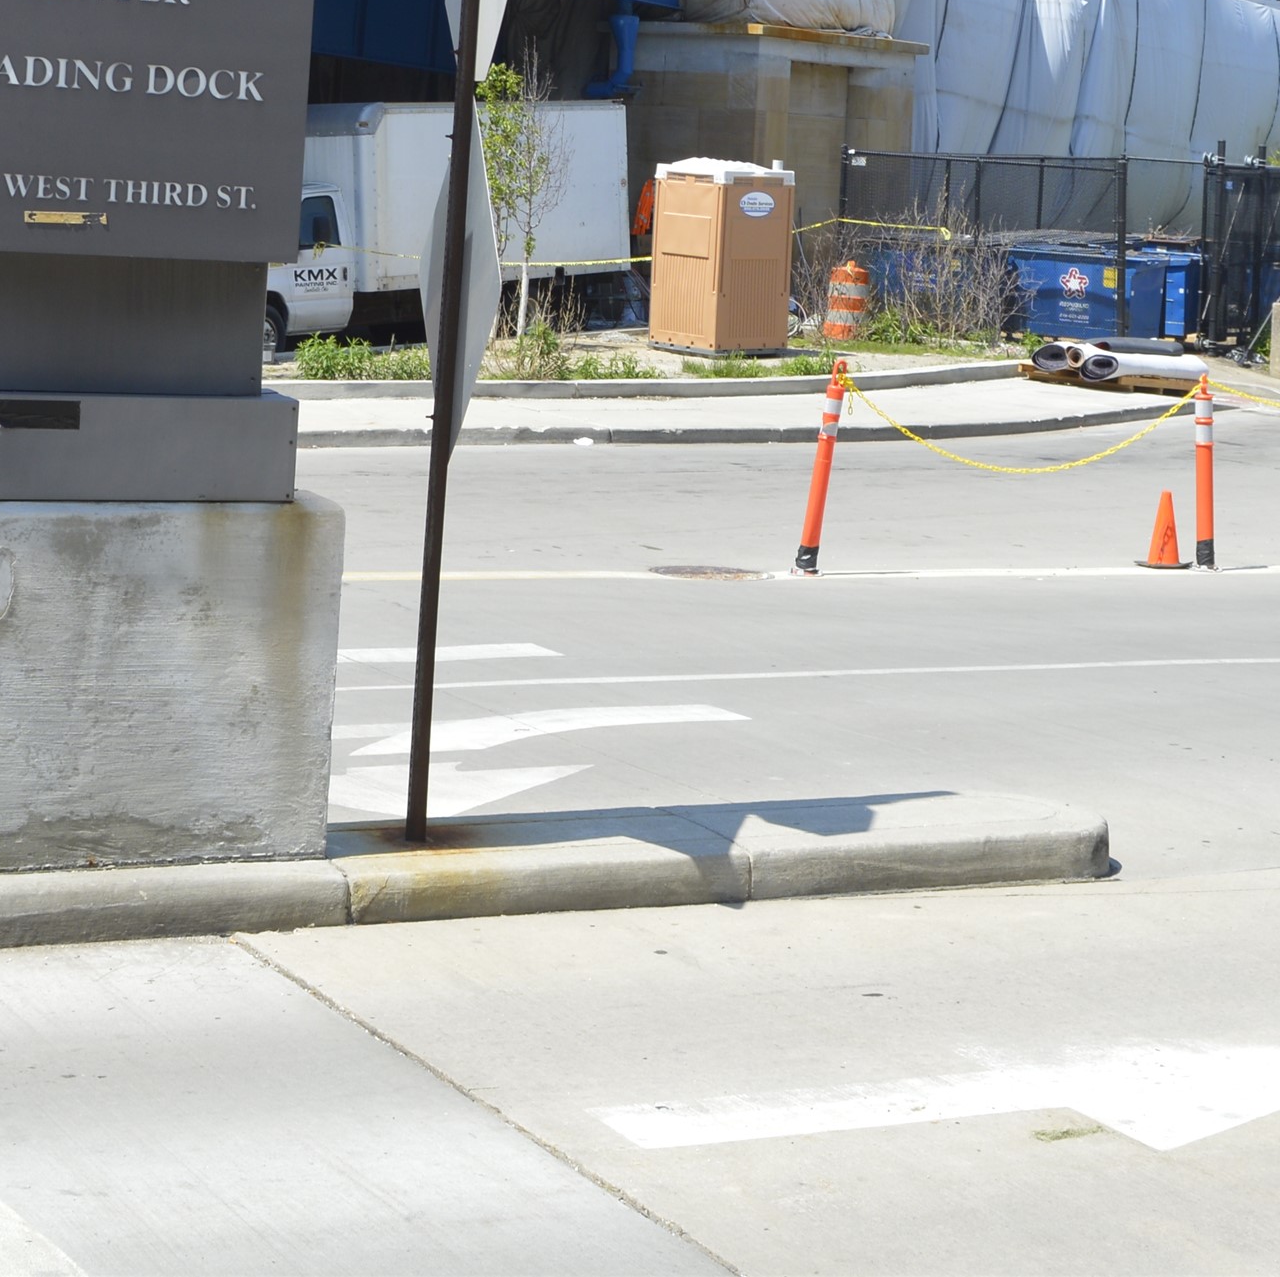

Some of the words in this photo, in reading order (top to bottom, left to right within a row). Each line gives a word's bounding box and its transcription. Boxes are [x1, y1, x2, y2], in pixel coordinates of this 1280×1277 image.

[145, 63, 264, 102] DOCK
[3, 172, 95, 202] WEST
[103, 178, 208, 208] THIRD
[215, 183, 258, 211] ST.
[294, 268, 337, 281] KMX
